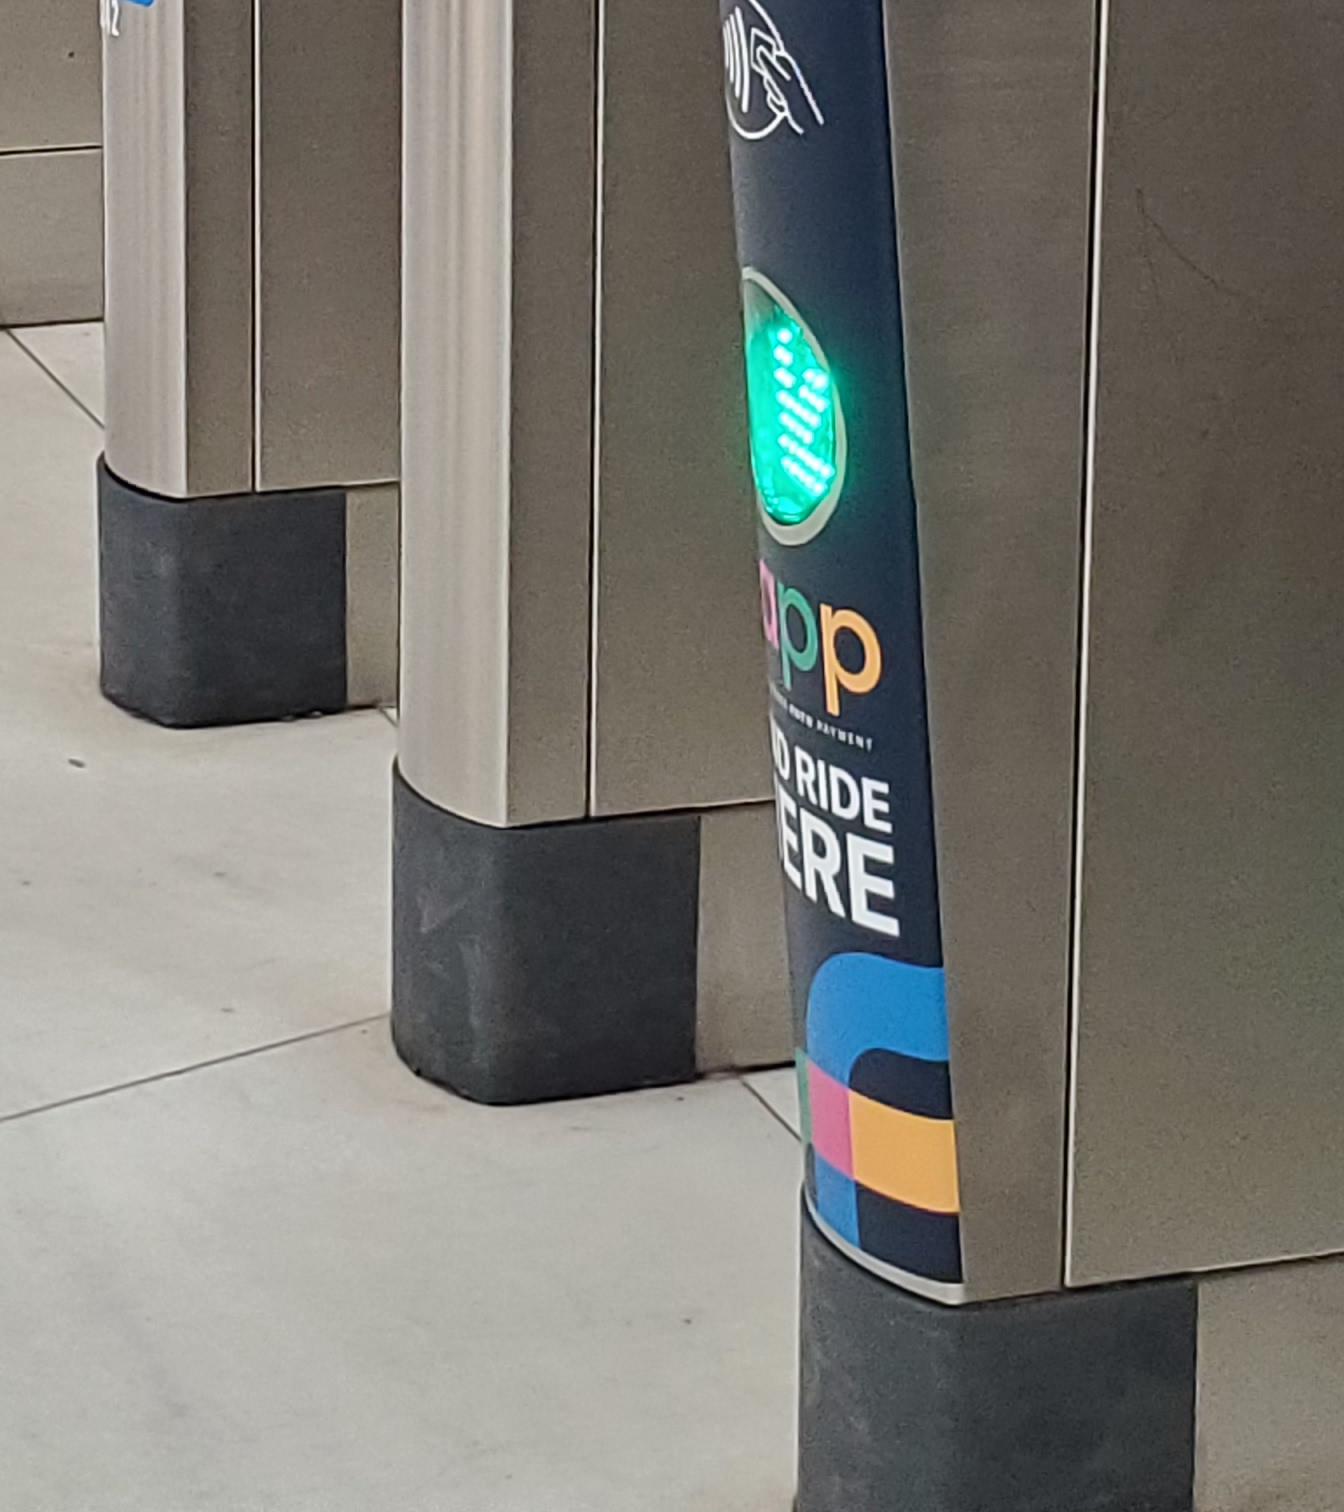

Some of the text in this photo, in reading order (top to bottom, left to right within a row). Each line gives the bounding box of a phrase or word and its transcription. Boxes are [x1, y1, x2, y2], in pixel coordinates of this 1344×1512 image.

[759, 558, 882, 717] app
[774, 774, 900, 938] ERE
[794, 744, 893, 834] RIDE
